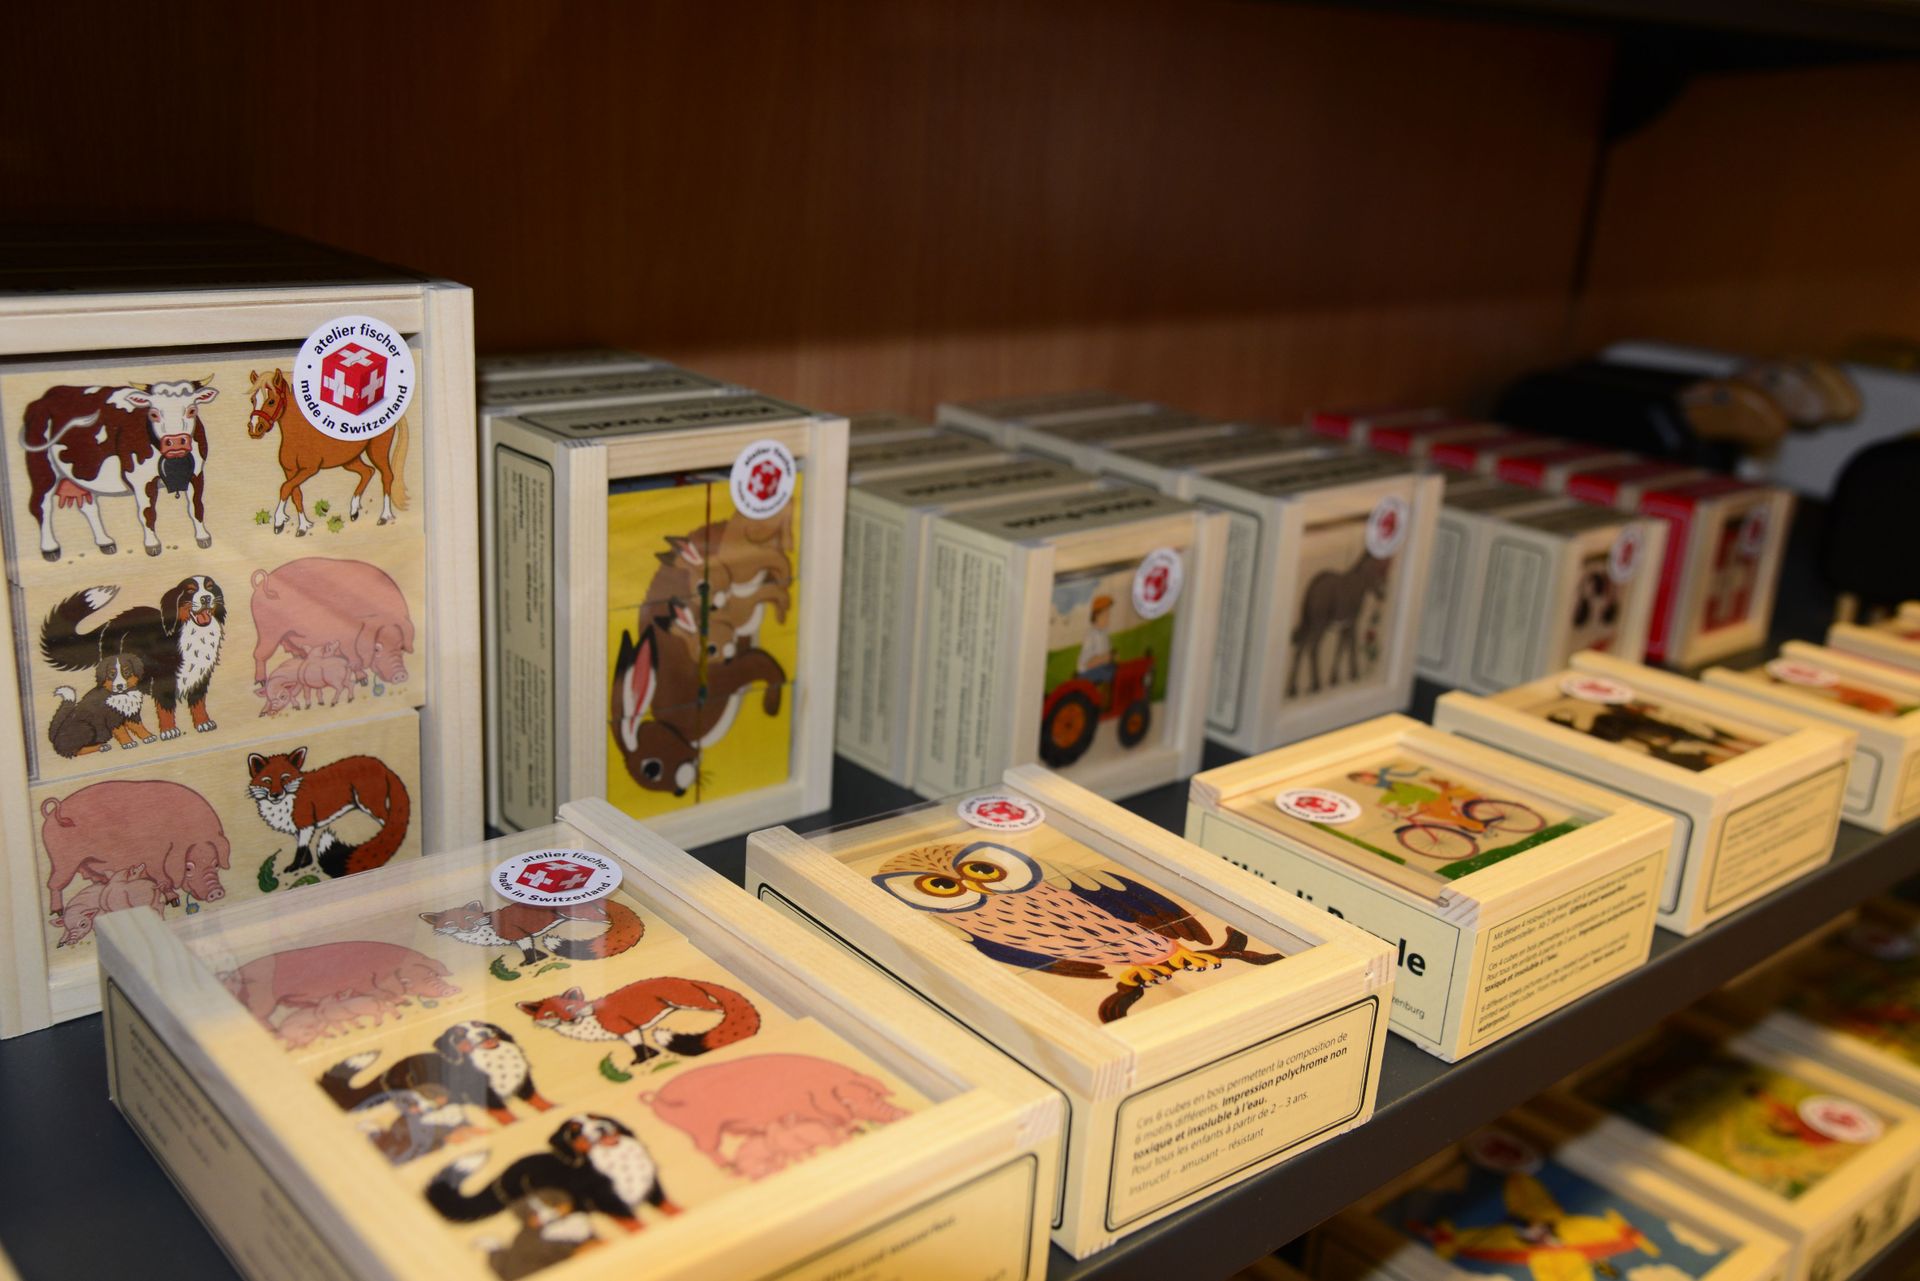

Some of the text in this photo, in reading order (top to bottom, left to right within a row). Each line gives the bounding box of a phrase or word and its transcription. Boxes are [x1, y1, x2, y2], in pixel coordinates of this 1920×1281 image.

[314, 323, 401, 358] atelier fischer
[301, 380, 408, 434] made in Switzerland
[499, 872, 611, 903] made in Switzerland
[522, 852, 610, 871] atelier fischer
[1164, 1100, 1191, 1117] cubes
[1193, 1094, 1205, 1105] en
[1206, 1085, 1224, 1099] bois
[1227, 1062, 1275, 1092] permettent
[1277, 1060, 1283, 1069] la
[1286, 1038, 1335, 1065] composition
[1337, 1032, 1347, 1043] de
[1222, 1079, 1273, 1107] Impression
[1275, 1055, 1328, 1086] polychrome
[1330, 1047, 1347, 1060] non
[1133, 1097, 1267, 1160] toxique et insoluble à l'eau.
[1155, 1150, 1174, 1166] tous
[1177, 1144, 1188, 1155] les
[1190, 1128, 1223, 1149] enfants
[1225, 1123, 1231, 1134] à
[1232, 1114, 1256, 1132] partir
[1257, 1108, 1268, 1119] de
[1270, 1103, 1276, 1114] 2
[1286, 1096, 1291, 1107] 3
[1180, 1148, 1219, 1173] amusant
[1228, 1128, 1263, 1150] résistant
